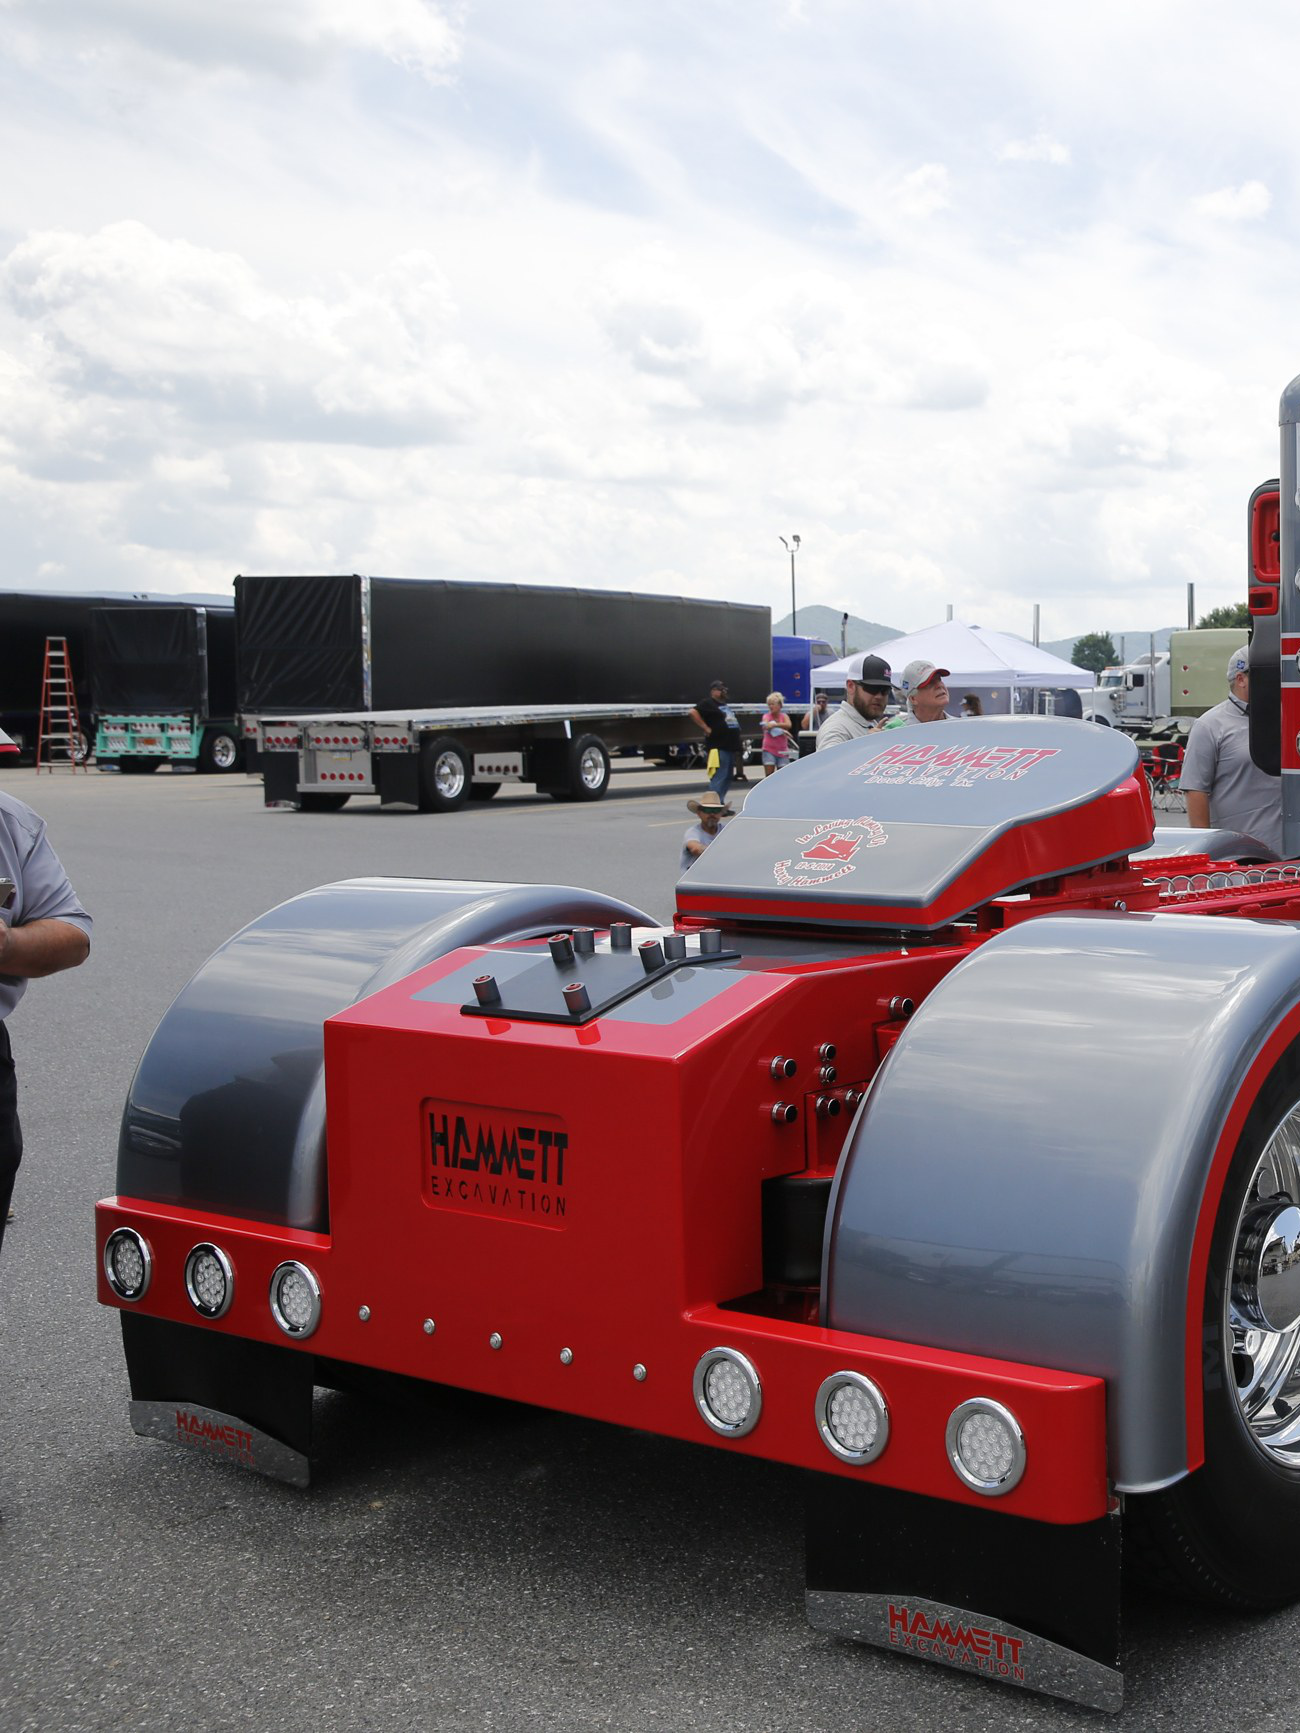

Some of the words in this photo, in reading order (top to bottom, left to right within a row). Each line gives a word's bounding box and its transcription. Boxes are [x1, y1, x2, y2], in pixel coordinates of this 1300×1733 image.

[848, 765, 1028, 781] EXCAVATION
[865, 744, 1062, 770] HAMMETT
[813, 819, 854, 837] Loving
[788, 864, 857, 887] Hammett
[429, 1112, 568, 1186] HAMMETT
[431, 1176, 567, 1217] EXCAVATION
[176, 1410, 253, 1452] HAMMETT
[888, 1603, 1024, 1664] HAMMETT
[889, 1629, 1025, 1681] EXCAVATION
